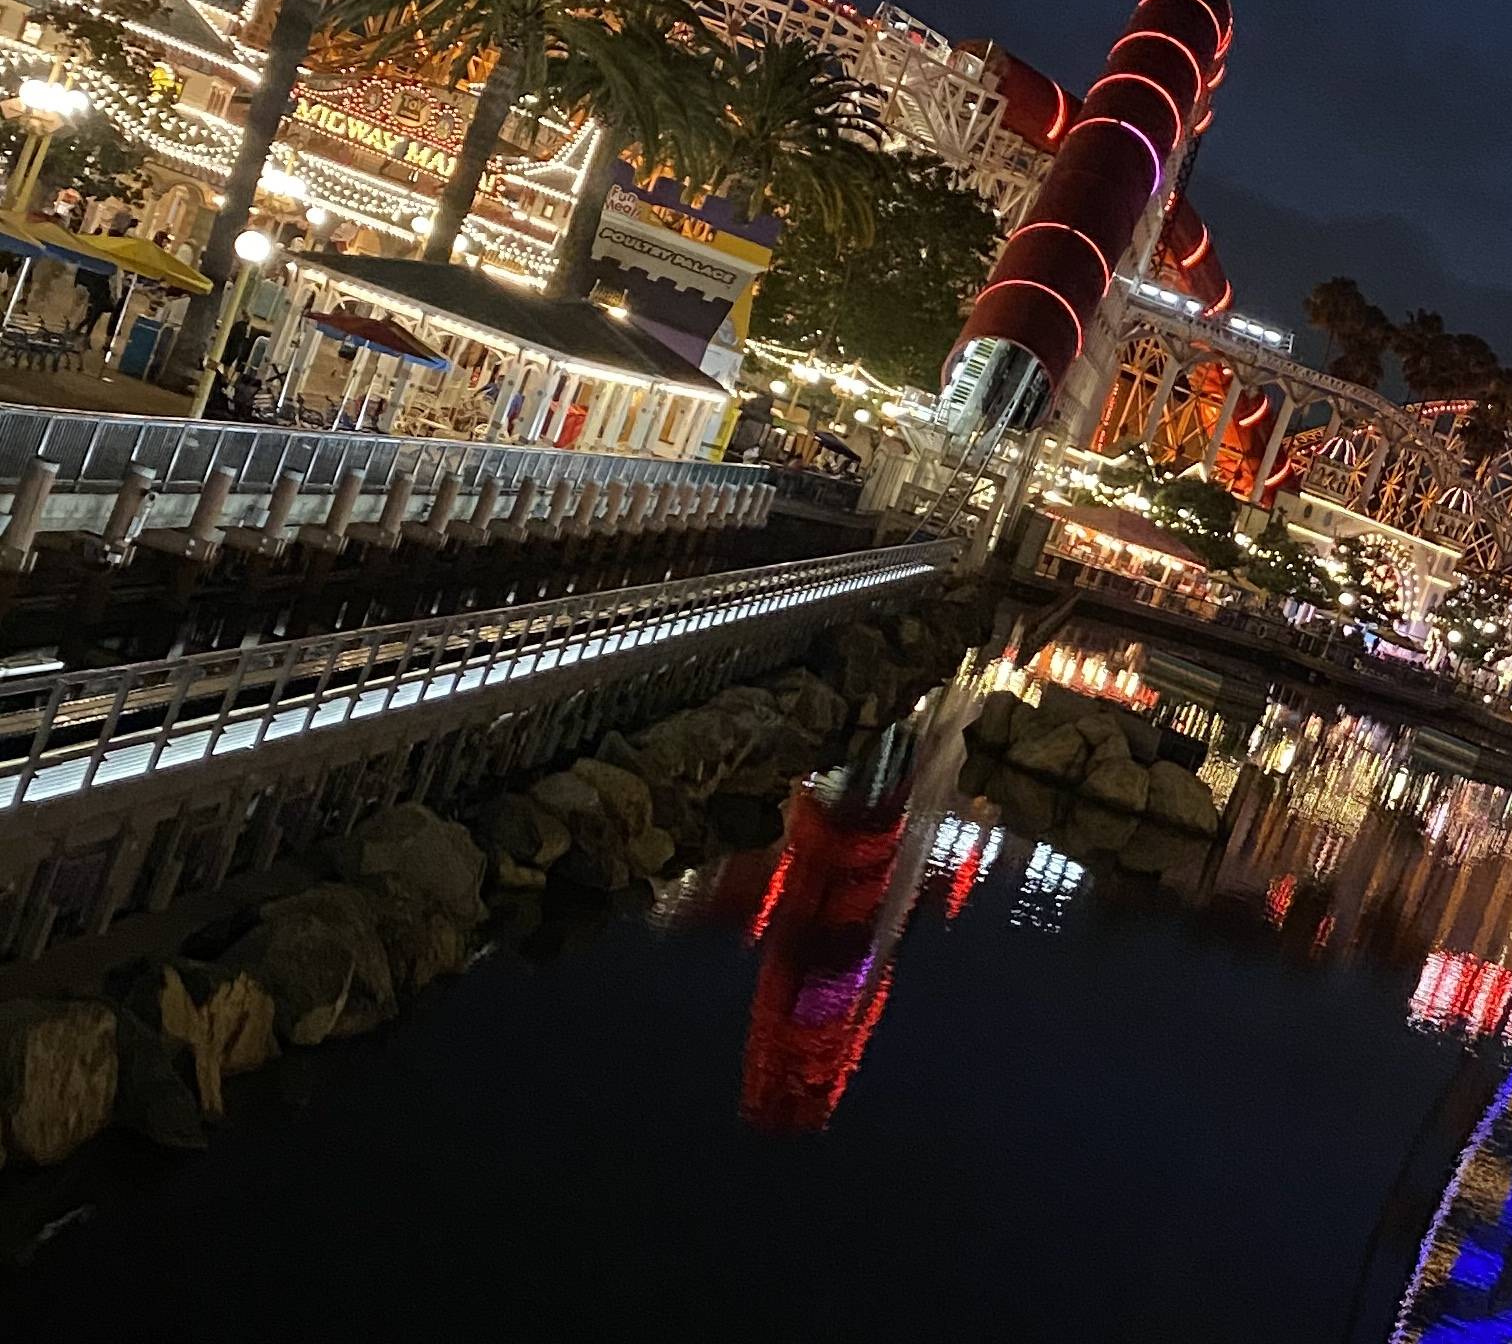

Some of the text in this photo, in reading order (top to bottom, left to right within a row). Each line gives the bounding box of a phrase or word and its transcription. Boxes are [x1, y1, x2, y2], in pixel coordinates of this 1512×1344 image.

[293, 97, 405, 156] MIDWAY
[611, 185, 637, 203] Fun
[599, 227, 736, 285] POULTRY PALACE
